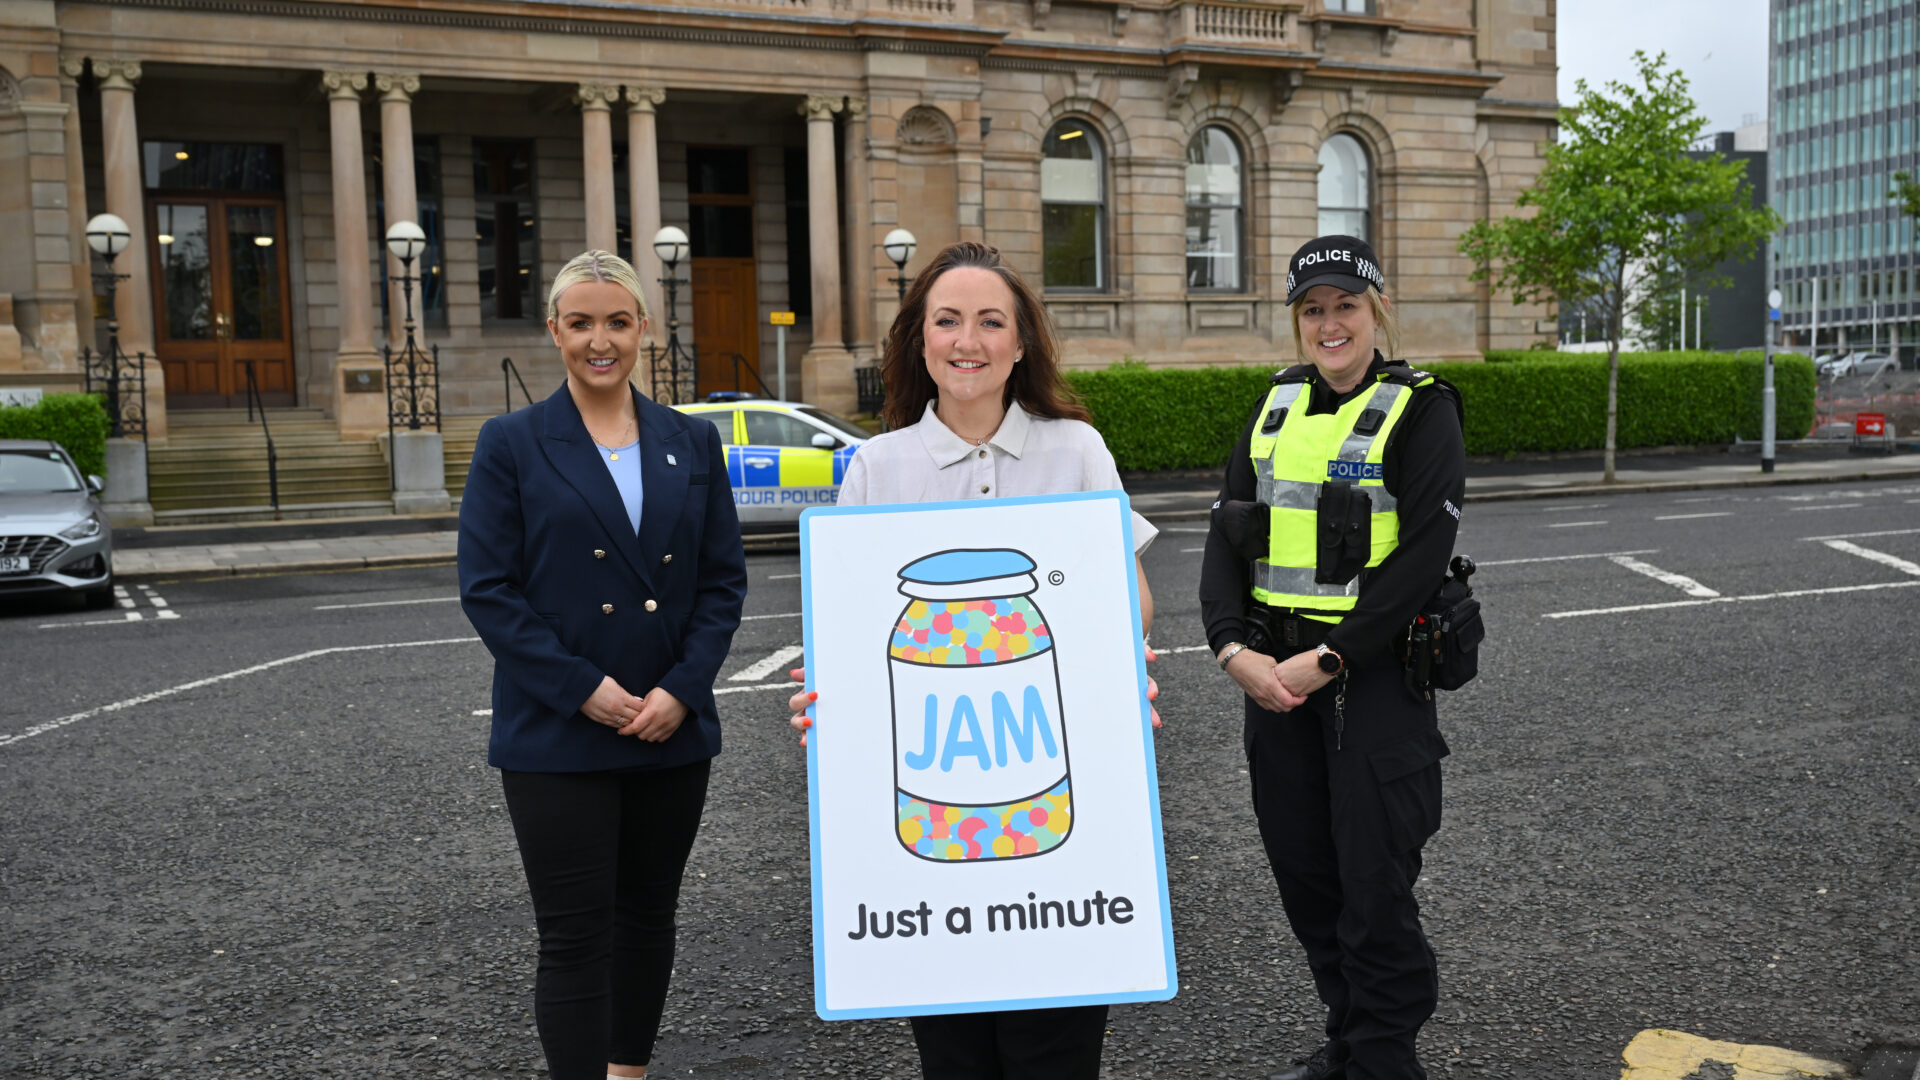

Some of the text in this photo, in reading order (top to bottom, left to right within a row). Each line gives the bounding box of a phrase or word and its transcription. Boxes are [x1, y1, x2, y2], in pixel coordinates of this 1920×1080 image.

[1298, 249, 1351, 271] POLICE
[1328, 463, 1382, 477] POLICE
[781, 489, 840, 504] POLICE
[904, 684, 1058, 773] JAM
[847, 890, 1134, 941] Just a minute
